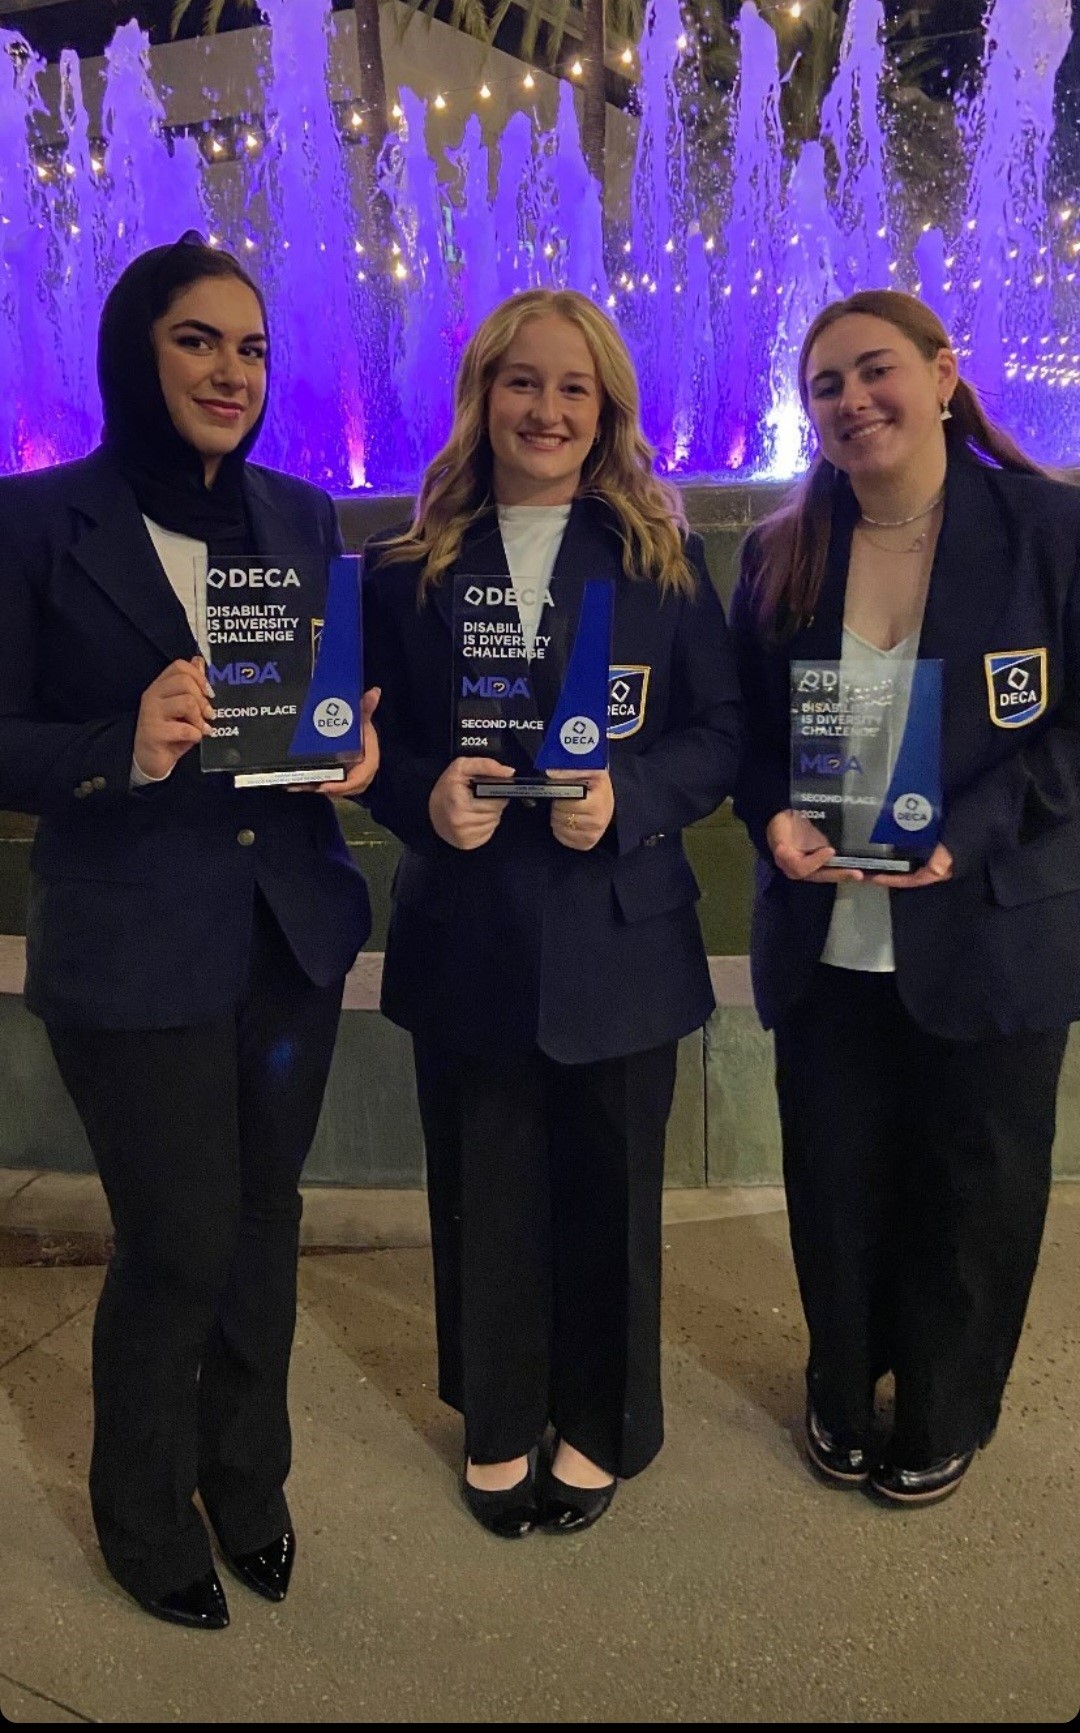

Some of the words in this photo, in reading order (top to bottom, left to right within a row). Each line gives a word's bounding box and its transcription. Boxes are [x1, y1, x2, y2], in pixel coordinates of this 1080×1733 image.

[229, 568, 300, 588] DECA
[206, 605, 286, 618] DISABILITY
[207, 620, 220, 631] IS
[224, 617, 300, 630] DIVERSITY
[463, 621, 536, 634] DISABILI
[208, 630, 294, 644] CHALLENGE
[463, 634, 476, 645] IS
[479, 634, 551, 647] DIVERSTY
[462, 646, 545, 659] CHALLENGE
[208, 661, 282, 685] MDA
[462, 676, 531, 699] MDA
[1000, 689, 1037, 706] DECA
[260, 704, 297, 716] PLACE
[317, 718, 349, 727] DECA
[461, 719, 507, 729] SECOND
[508, 719, 544, 730] PLACE
[802, 714, 813, 725] IS
[210, 725, 240, 738] 2024
[461, 736, 489, 747] 2024
[564, 736, 595, 745] DECA
[801, 792, 842, 803] SECOND
[801, 809, 826, 820] 2024
[897, 811, 928, 821] DECA
